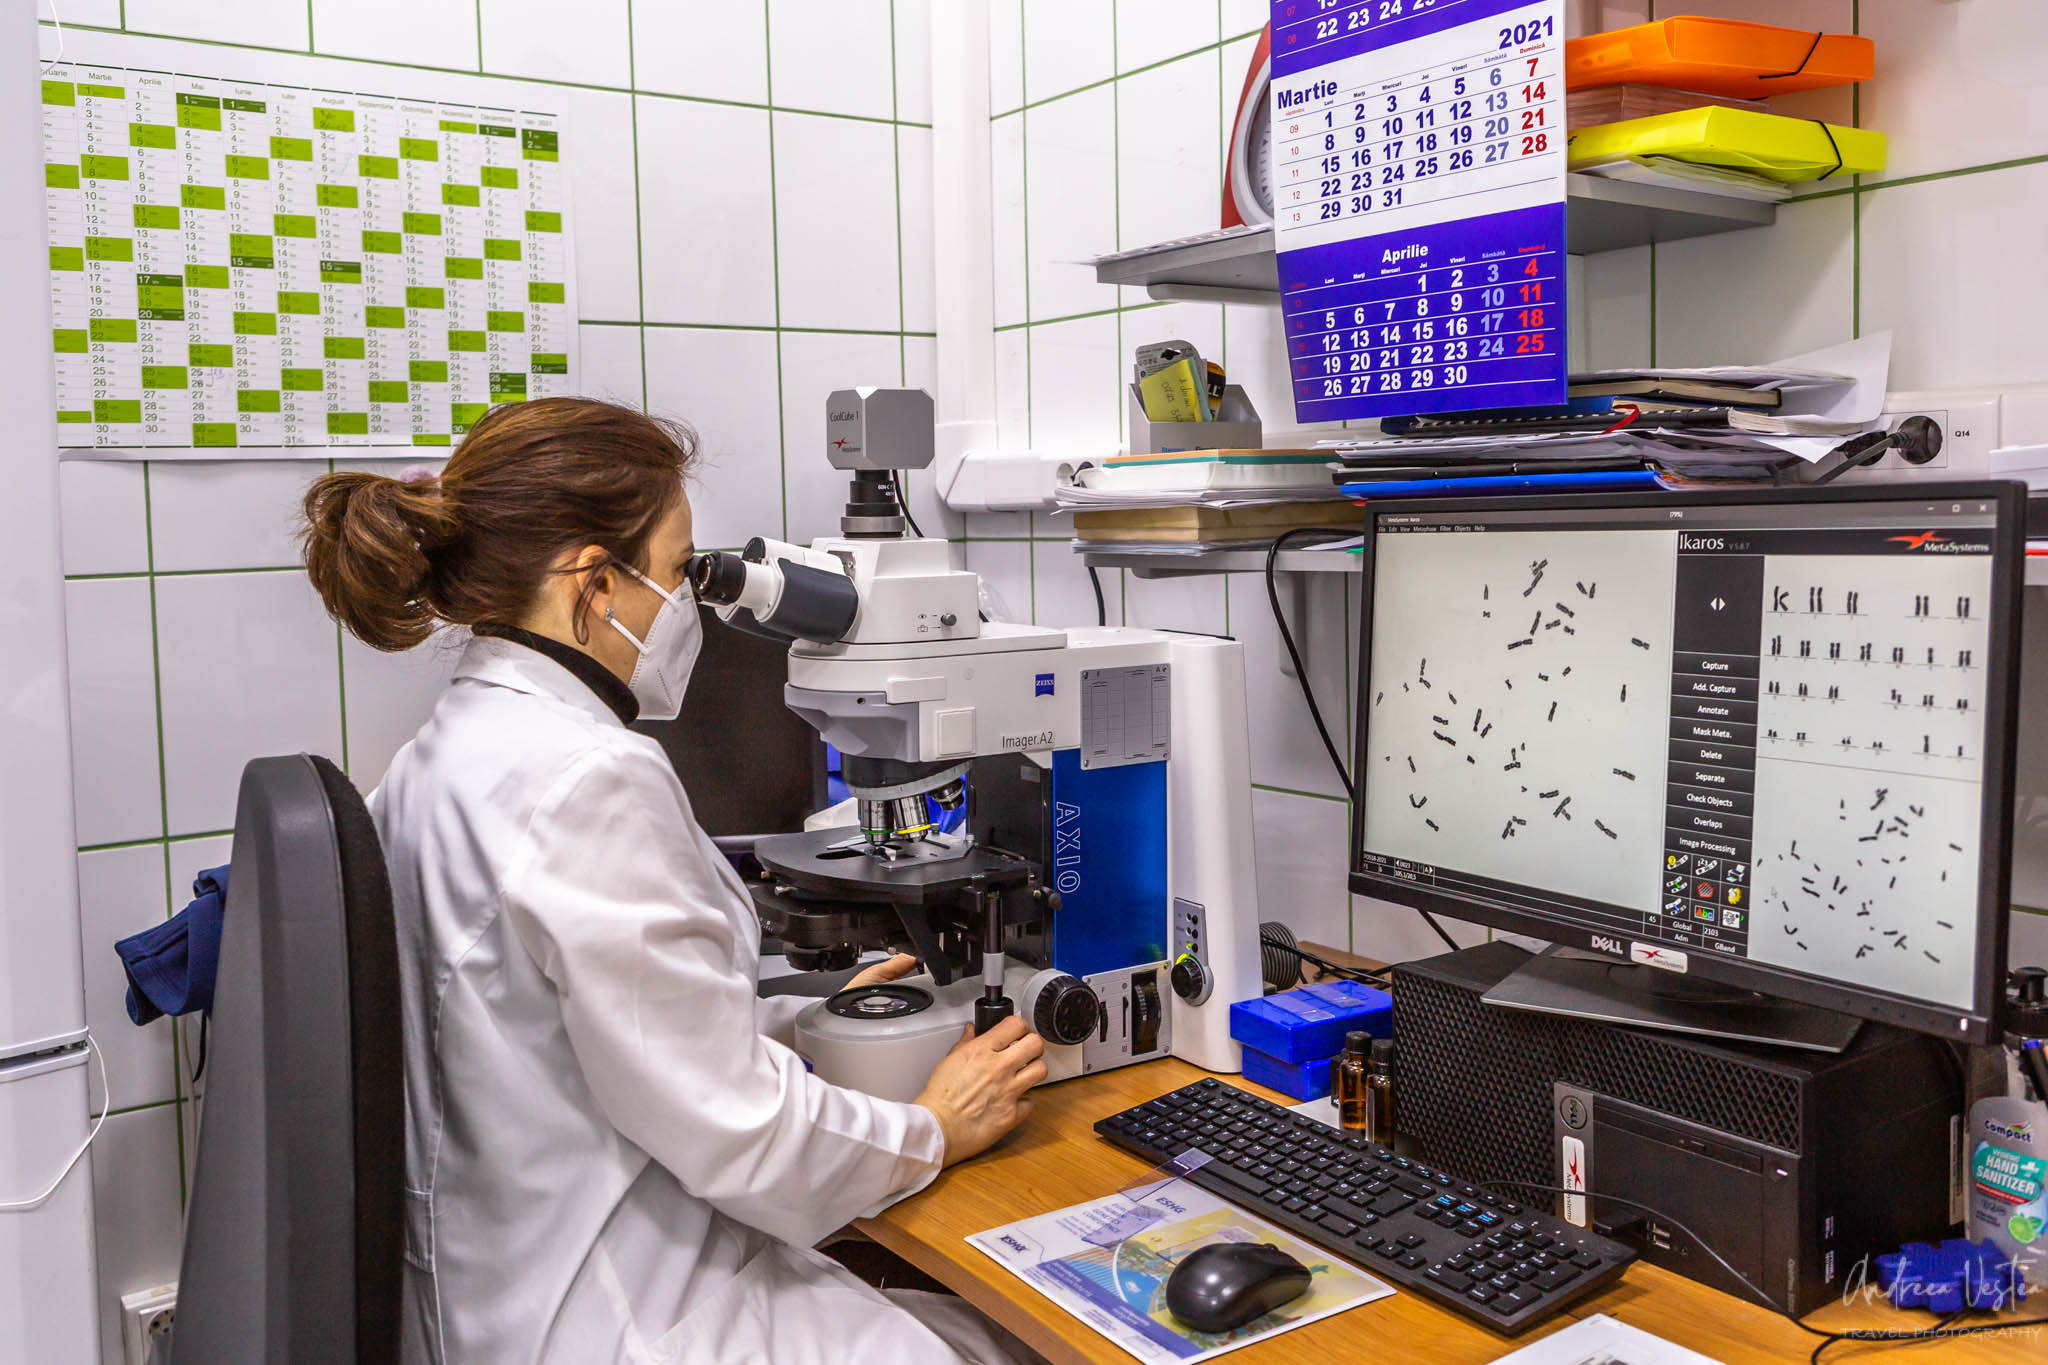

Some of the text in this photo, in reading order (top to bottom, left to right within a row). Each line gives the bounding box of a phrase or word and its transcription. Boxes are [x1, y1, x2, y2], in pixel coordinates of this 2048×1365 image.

[1316, 18, 1338, 40] 22
[1347, 8, 1370, 30] 23
[1379, 0, 1402, 21] 24
[1499, 15, 1553, 50] 2021
[88, 72, 112, 81] Martie
[138, 77, 162, 86] Aprilie
[1277, 80, 1338, 110] Martie
[1324, 111, 1332, 128] 1
[1354, 103, 1365, 121] 2
[1386, 95, 1397, 113] 3
[1419, 86, 1431, 104] 4
[1454, 77, 1466, 96] 5
[1490, 68, 1502, 87] 6
[1526, 57, 1539, 77] 7
[1324, 134, 1335, 151] 8
[1355, 126, 1366, 144] 9
[1382, 117, 1403, 137] 10
[1415, 108, 1434, 129] 11
[1449, 101, 1472, 121] 12
[1485, 91, 1508, 113] 13
[1521, 81, 1546, 104] 14
[1321, 155, 1341, 175] 15
[1351, 148, 1372, 168] 16
[1383, 140, 1404, 161] 17
[1415, 133, 1437, 153] 18
[1449, 125, 1472, 146] 19
[1484, 116, 1509, 139] 20
[1521, 107, 1545, 131] 21
[1320, 178, 1342, 198] 22
[1351, 171, 1372, 191] 23
[1382, 163, 1405, 185] 24
[1415, 156, 1438, 178] 25
[1449, 149, 1473, 171] 26
[1485, 141, 1509, 164] 27
[1521, 133, 1548, 156] 28
[1320, 200, 1341, 220] 29
[1351, 194, 1372, 214] 30
[1382, 187, 1402, 208] 31
[1381, 244, 1429, 265] Aprilie
[138, 276, 150, 284] 17
[1417, 258, 1539, 292] 1 2 3 4
[139, 310, 152, 319] 20
[1325, 311, 1336, 329] 5
[1354, 307, 1365, 325] 6
[1384, 302, 1396, 321] 7
[1417, 298, 1429, 316] 8
[1450, 293, 1463, 312] 9
[1481, 287, 1505, 307] 10
[1519, 283, 1541, 303] 11
[1322, 333, 1341, 352] 12
[1350, 329, 1370, 348] 13
[1380, 325, 1401, 345] 14
[1412, 321, 1434, 341] 15
[1445, 317, 1468, 337] 16
[1481, 313, 1504, 332] 17
[1518, 308, 1544, 328] 18
[1323, 356, 1341, 374] 19
[1350, 352, 1371, 372] 20
[1380, 348, 1399, 368] 21
[1410, 344, 1434, 365] 22
[1443, 341, 1468, 361] 23
[1479, 337, 1505, 357] 24
[1516, 333, 1545, 354] 25
[1323, 378, 1343, 397] 26
[1350, 375, 1371, 394] 27
[1380, 372, 1402, 391] 28
[1411, 368, 1434, 388] 29
[1444, 365, 1468, 385] 30
[830, 411, 855, 423] CoolCube
[96, 436, 109, 445] 31
[1954, 429, 1970, 437] Q14
[1679, 534, 1724, 550] Ikaros
[1923, 541, 1990, 553] MetaSystems
[1701, 661, 1729, 672] Capture
[1036, 679, 1054, 687] ZEISS
[1692, 682, 1737, 694] Add. Capture
[1697, 705, 1729, 715] Annotate
[1692, 726, 1711, 735] Mask
[1002, 731, 1053, 750] Imager.A2
[1700, 750, 1722, 760] Delete
[1695, 772, 1725, 784] Separate
[1686, 793, 1733, 808] Check Objects
[1693, 817, 1723, 829] Overlaps
[1055, 801, 1081, 894] AXIO
[1679, 837, 1736, 855] Image Processing
[1672, 921, 1692, 931] Global
[1704, 927, 1719, 937] 2103
[1591, 935, 1624, 955] DELL
[1674, 934, 1689, 943] Adm
[1984, 1120, 2032, 1142] Compact
[1985, 1154, 2019, 1176] HAND
[1976, 1165, 2036, 1196] SANITIZER
[1155, 1196, 1187, 1214] ESHG
